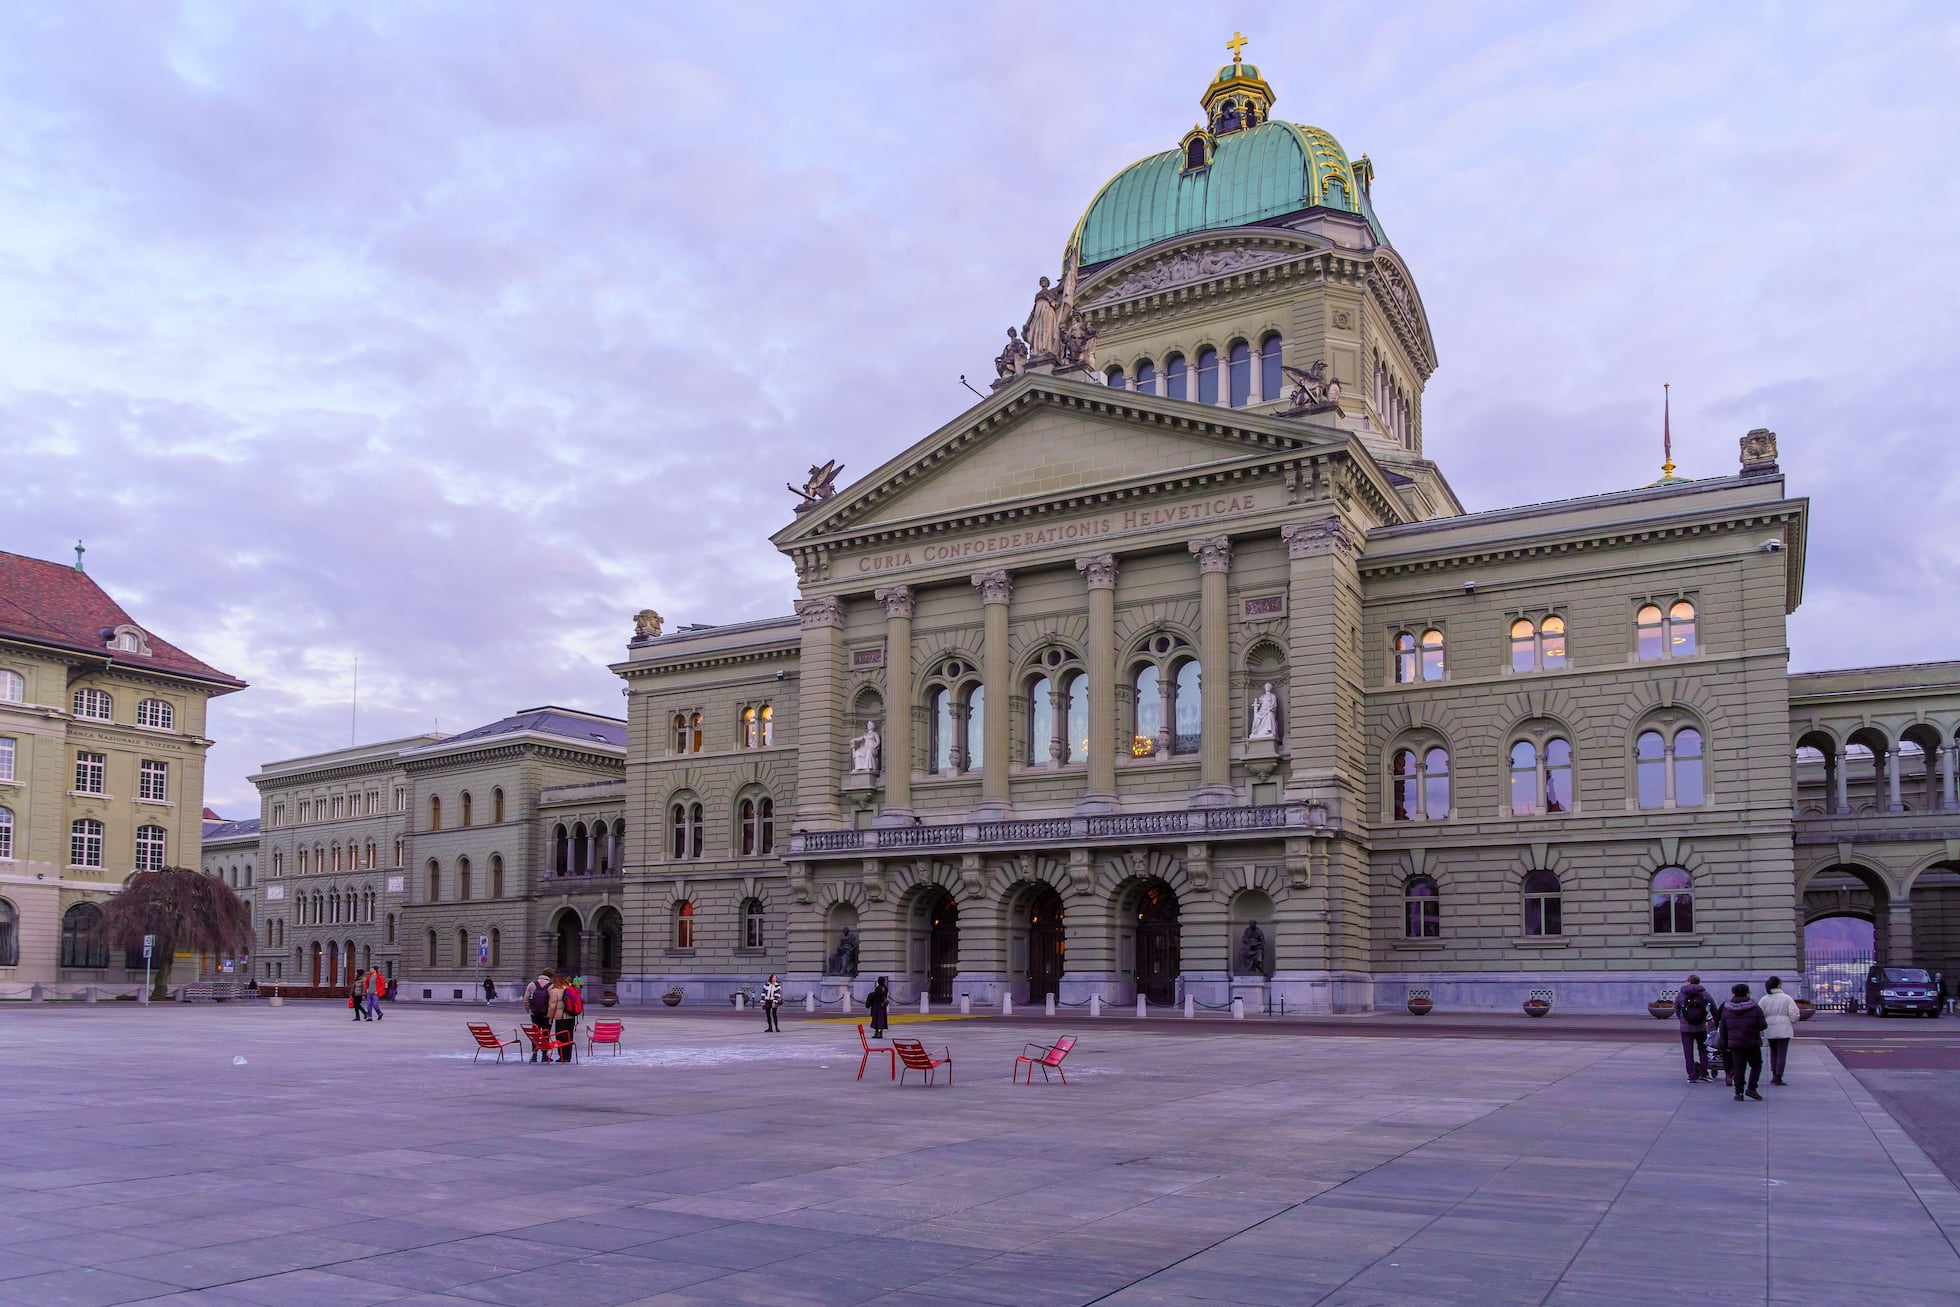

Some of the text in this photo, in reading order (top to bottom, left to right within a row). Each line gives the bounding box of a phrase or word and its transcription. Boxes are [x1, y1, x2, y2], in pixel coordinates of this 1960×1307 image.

[858, 495, 1255, 572] CURIA CONFOEDERATIONIS HELVETICAE
[66, 729, 182, 751] BANCA NAZIONALE SVIZZERA
